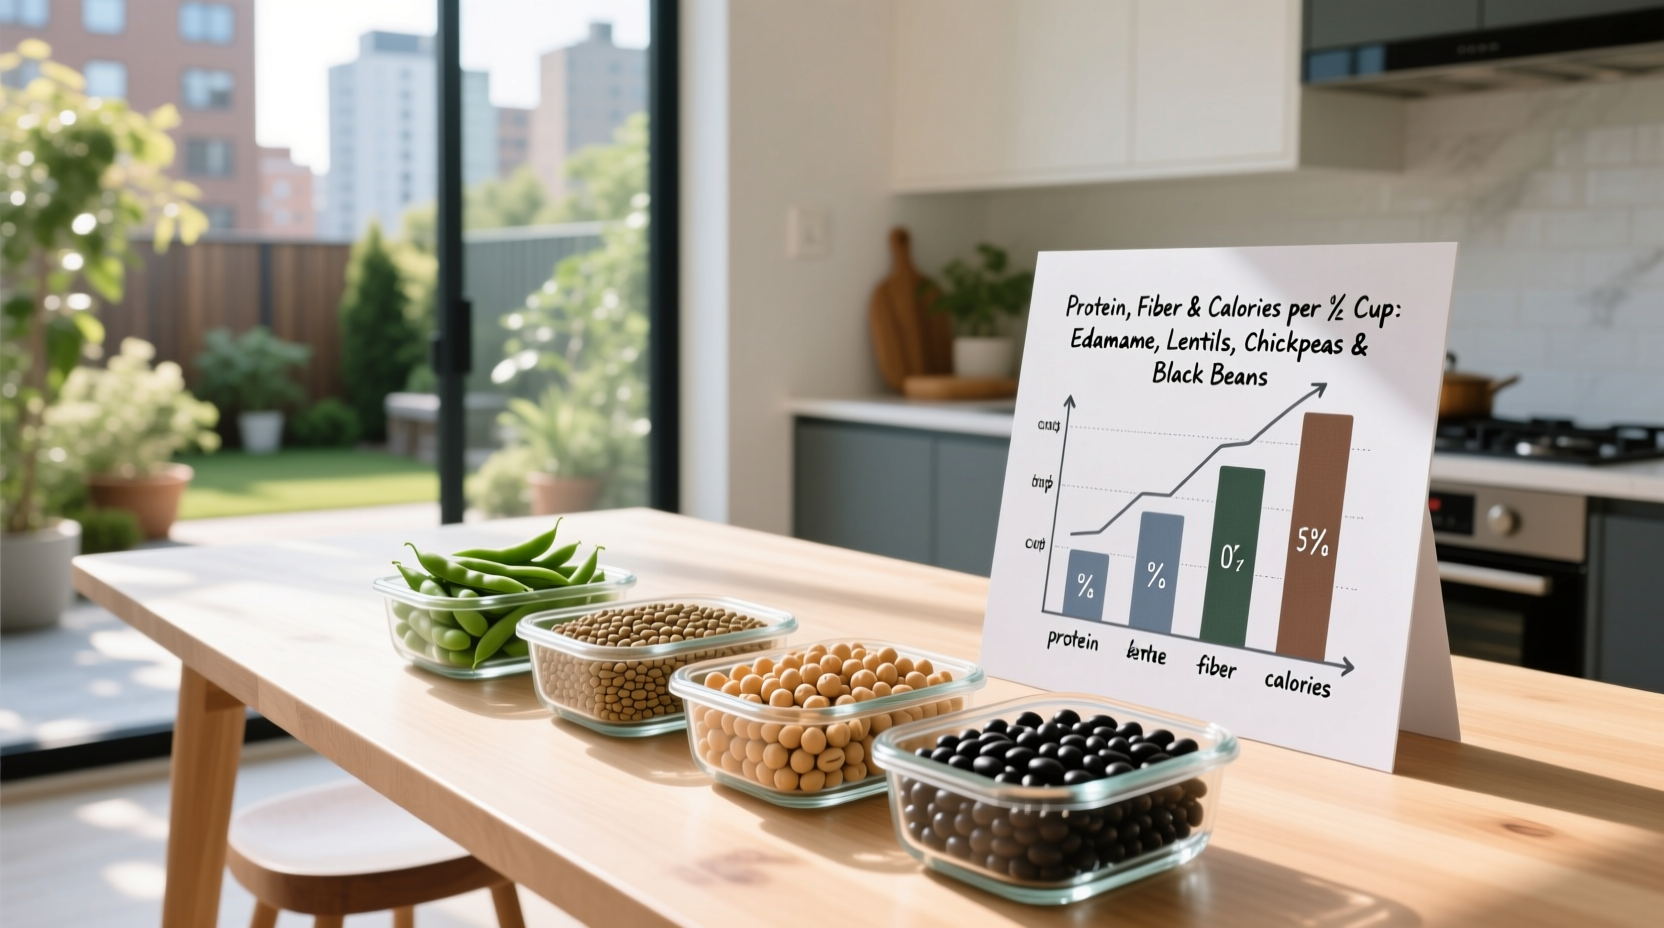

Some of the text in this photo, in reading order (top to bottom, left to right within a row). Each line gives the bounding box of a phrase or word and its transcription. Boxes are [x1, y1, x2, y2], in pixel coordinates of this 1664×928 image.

[1065, 294, 1131, 321] Protein,
[1137, 294, 1183, 317] Fiber
[1186, 295, 1202, 317] &
[1208, 295, 1282, 318] Calories
[1286, 303, 1322, 327] per
[1353, 294, 1402, 329] Cup:
[1070, 326, 1369, 363] Edamame, Lentils, Chickpeas &
[1152, 360, 1268, 387] Black Beans
[1296, 526, 1329, 557] 5%
[1046, 629, 1099, 651] protein
[1196, 654, 1238, 680] fiber
[1264, 669, 1331, 699] calories
